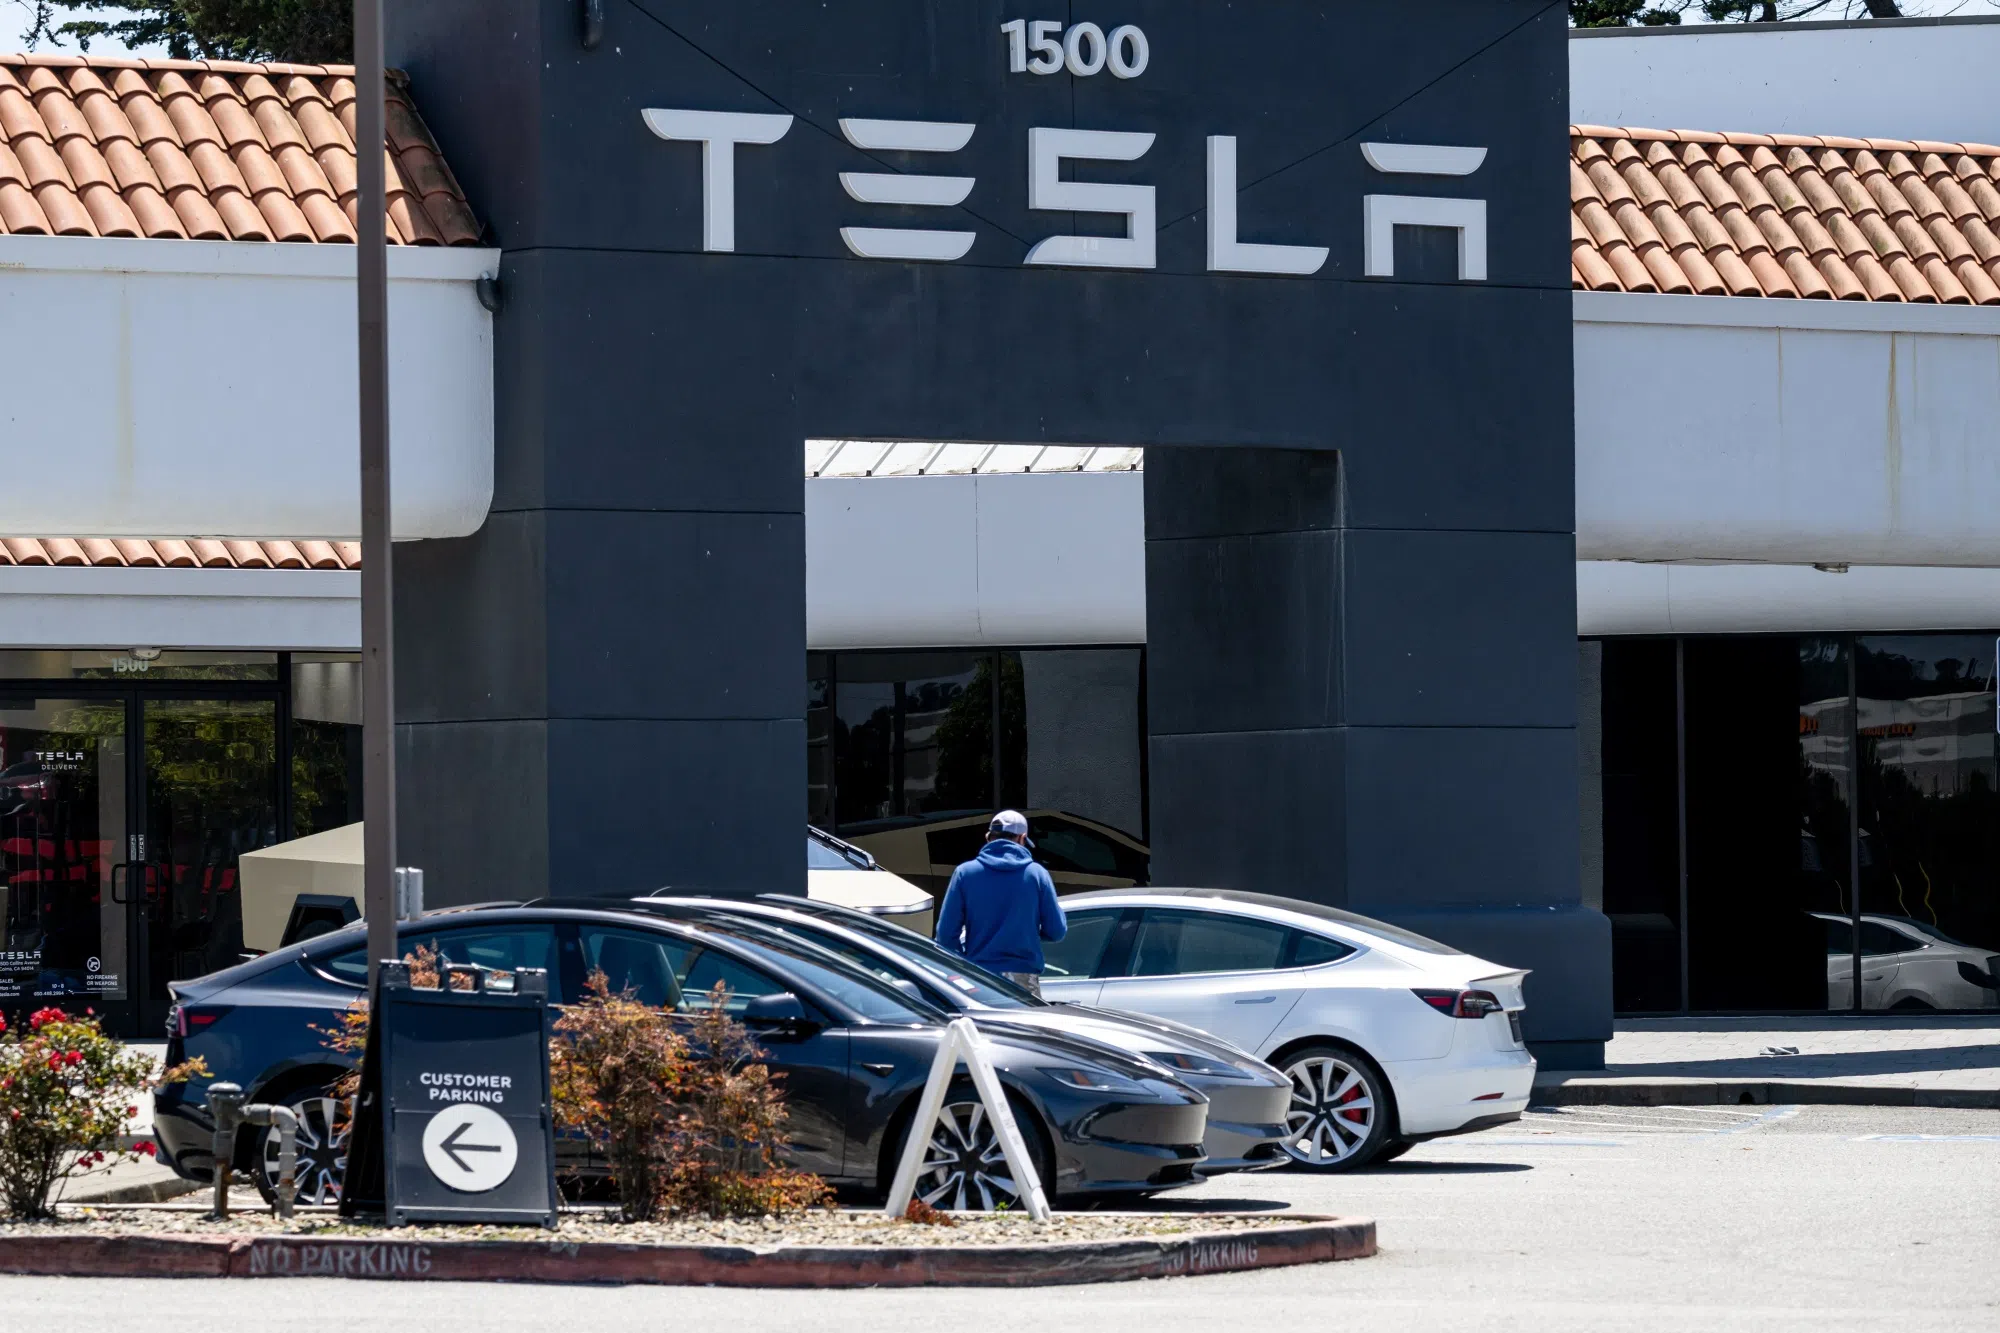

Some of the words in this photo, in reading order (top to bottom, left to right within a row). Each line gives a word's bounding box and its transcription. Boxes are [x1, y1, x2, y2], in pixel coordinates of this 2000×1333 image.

[1001, 19, 1149, 79] 1500
[641, 108, 1487, 281] TESLA
[112, 657, 149, 673] 1500
[36, 752, 83, 761] TESLA
[0, 951, 42, 960] TESLA
[419, 1072, 512, 1089] CUSTOMER
[429, 1087, 504, 1103] PARKING
[250, 1244, 291, 1275] NO
[302, 1246, 432, 1274] PARKING
[1189, 1240, 1259, 1269] PARKING
